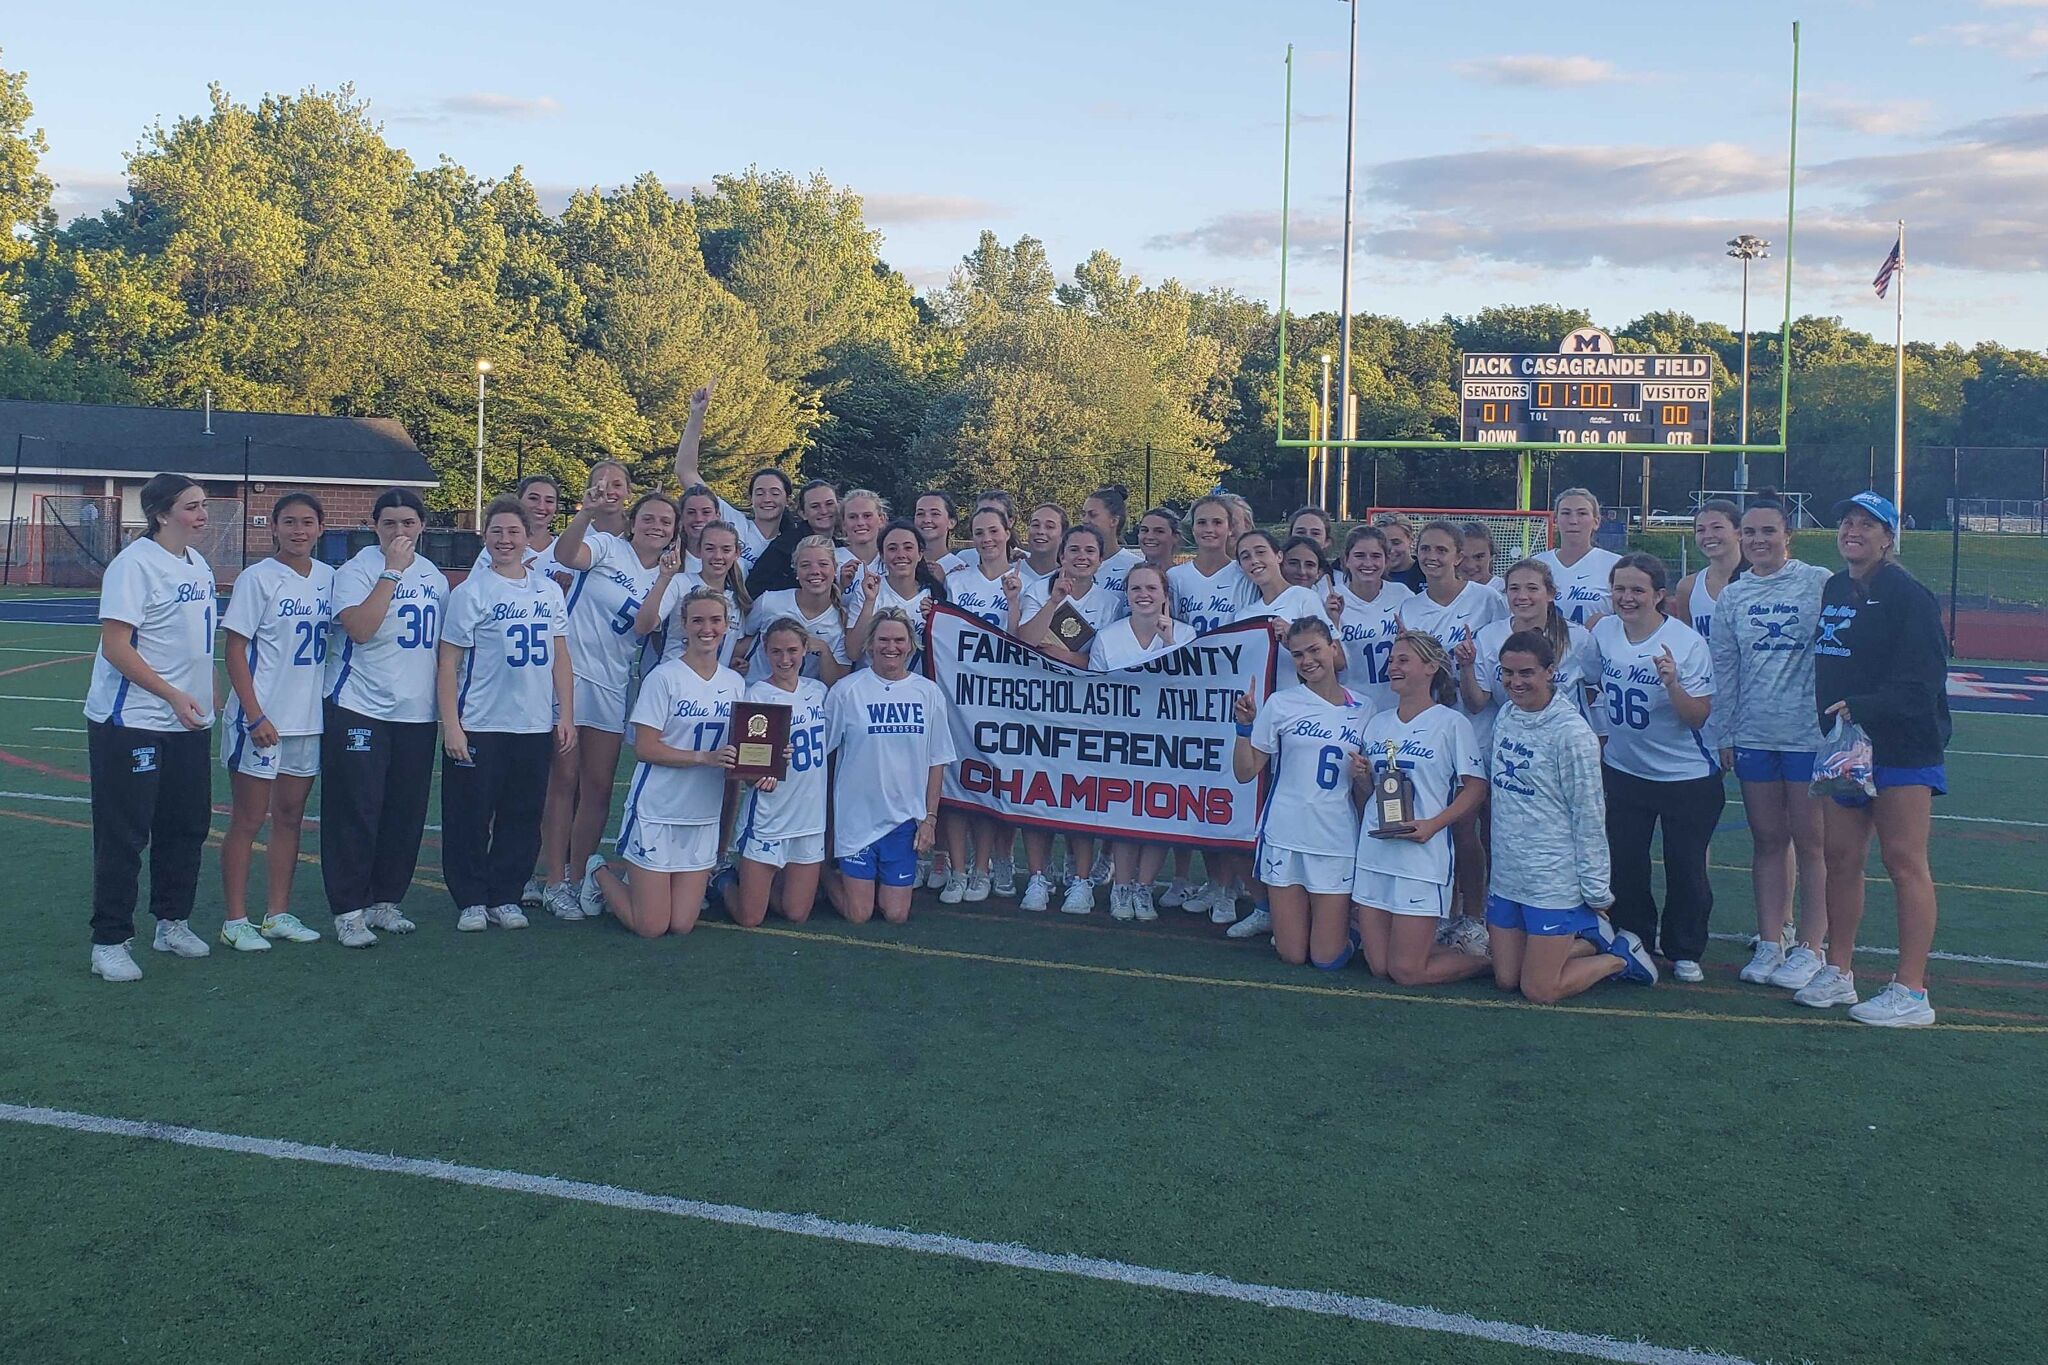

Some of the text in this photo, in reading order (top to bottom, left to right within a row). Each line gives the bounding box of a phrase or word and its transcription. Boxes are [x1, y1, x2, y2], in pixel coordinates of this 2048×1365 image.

[1573, 334, 1601, 352] M
[1466, 358, 1707, 376] JACK CASAGRANDE FIELD
[1466, 385, 1528, 398] SENATORS
[1645, 387, 1708, 400] VISITOR
[1529, 412, 1549, 421] TOL
[1622, 412, 1641, 422] TOL
[1662, 405, 1689, 425] 00
[1478, 429, 1517, 443] DOWN
[1558, 430, 1627, 444] TO GO ON
[175, 582, 206, 602] Blue
[610, 570, 639, 596] Blue
[958, 592, 987, 608] Blue
[1567, 586, 1601, 602] Wave
[278, 598, 313, 617] Blue
[492, 602, 528, 621] Blue
[1207, 595, 1236, 613] Wave
[397, 603, 437, 649] 30
[1341, 623, 1377, 642] Blue
[293, 621, 330, 666] 26
[506, 623, 549, 668] 35
[956, 672, 1141, 718] INTERSCHOLASTIC
[674, 700, 709, 718] Blue
[867, 702, 925, 725] WAVE
[1605, 682, 1650, 730] 36
[693, 721, 726, 752] 17
[872, 725, 921, 735] LACROSSE
[1292, 719, 1333, 740] Blue
[790, 724, 824, 772] 85
[974, 720, 1225, 773] CONFERENCE
[1396, 739, 1435, 759] Wave
[1316, 744, 1344, 790] 6
[959, 758, 1234, 825] CHAMPIONS
